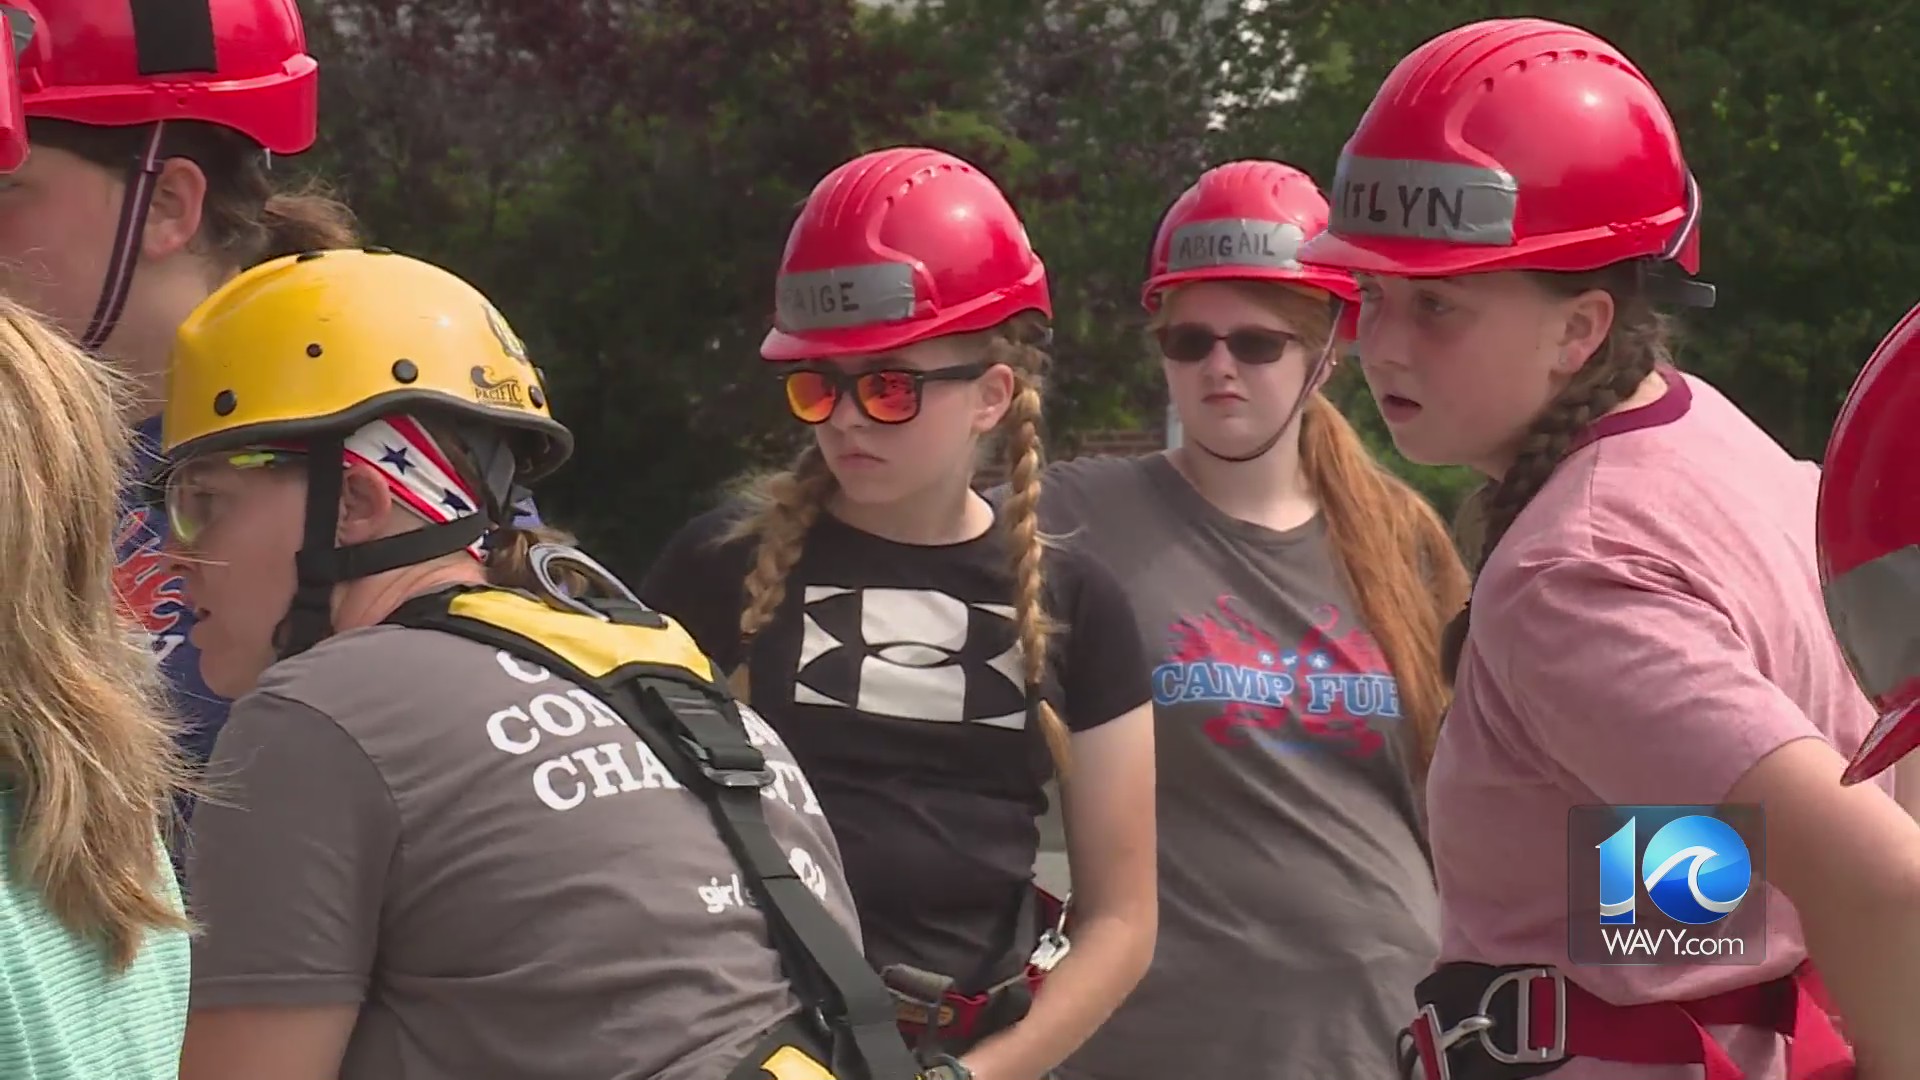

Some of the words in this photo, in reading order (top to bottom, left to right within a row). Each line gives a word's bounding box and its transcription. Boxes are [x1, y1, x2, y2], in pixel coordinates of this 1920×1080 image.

[1178, 232, 1276, 260] ABIGAIL
[475, 383, 523, 404] PACIFIC
[1152, 662, 1294, 707] CAMP
